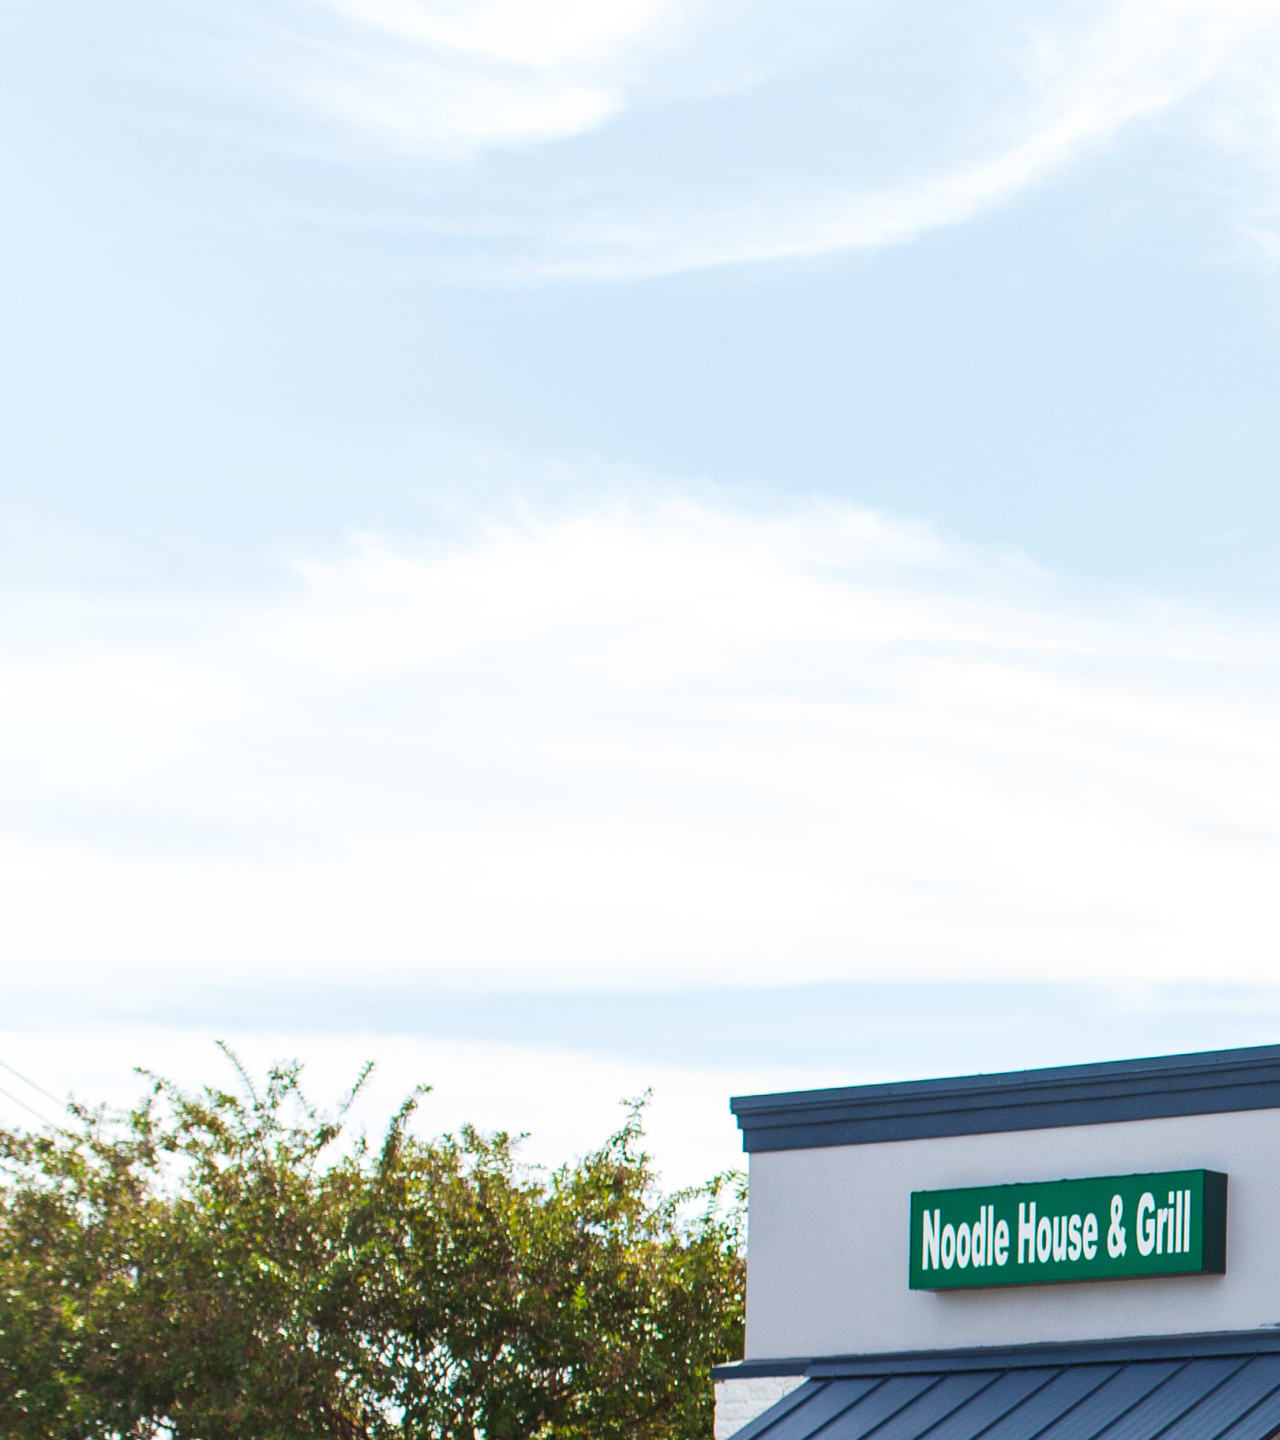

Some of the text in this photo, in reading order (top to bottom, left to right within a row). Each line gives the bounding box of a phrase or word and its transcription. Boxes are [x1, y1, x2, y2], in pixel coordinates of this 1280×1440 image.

[922, 1189, 1191, 1271] Noodle House & Grill
